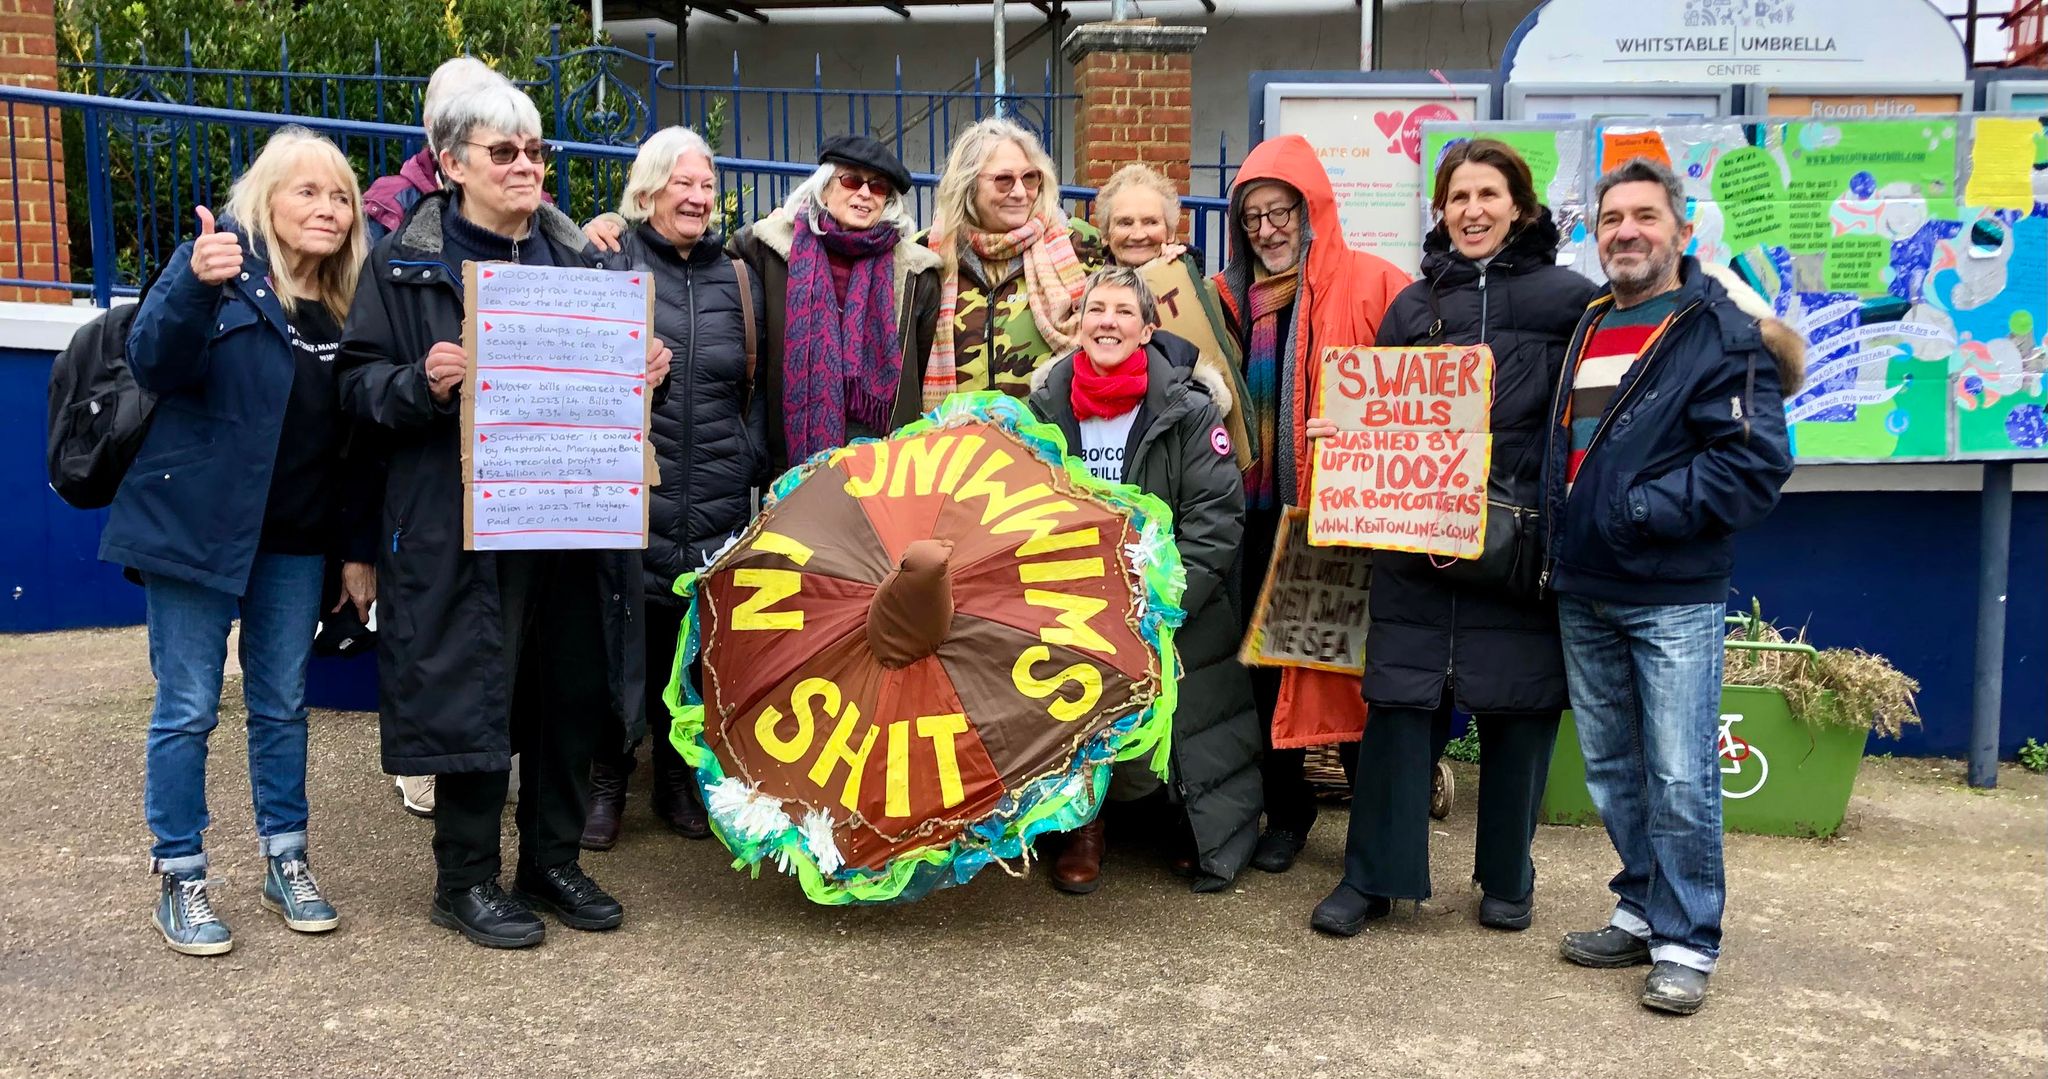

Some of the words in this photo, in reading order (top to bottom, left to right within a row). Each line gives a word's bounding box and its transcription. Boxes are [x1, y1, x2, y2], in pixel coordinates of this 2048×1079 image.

[1616, 37, 1729, 52] WHITSTABLE
[1741, 37, 1837, 51] UMBRELLA
[1707, 64, 1761, 76] CENTRE
[1811, 101, 1873, 117] Room
[1876, 101, 1916, 117] Hire
[1352, 148, 1370, 158] ON
[482, 284, 530, 298] dumping
[533, 286, 547, 296] of
[485, 297, 502, 306] sea
[498, 323, 526, 334] 358
[535, 324, 570, 339] dumps
[576, 327, 591, 338] of
[1860, 324, 1897, 336] Released
[1915, 325, 1928, 335] hrs
[1930, 329, 1940, 337] of
[602, 341, 615, 354] by
[594, 354, 625, 365] 2023
[539, 381, 560, 392] bills
[619, 384, 631, 397] by
[515, 394, 525, 404] in
[611, 396, 623, 405] to
[1842, 394, 1857, 402] this
[489, 408, 511, 417] rise
[518, 407, 530, 419] by
[569, 409, 581, 421] by
[1360, 400, 1450, 427] BILLS
[1426, 428, 1465, 451] BY
[485, 445, 499, 460] by
[505, 469, 537, 478] billion
[541, 470, 551, 478] in
[558, 469, 593, 478] 2023
[1375, 448, 1469, 490] 100%
[1319, 486, 1357, 512] FOR
[517, 516, 545, 526] CEO
[1302, 626, 1353, 664] SEA
[755, 677, 969, 818] SHIT
